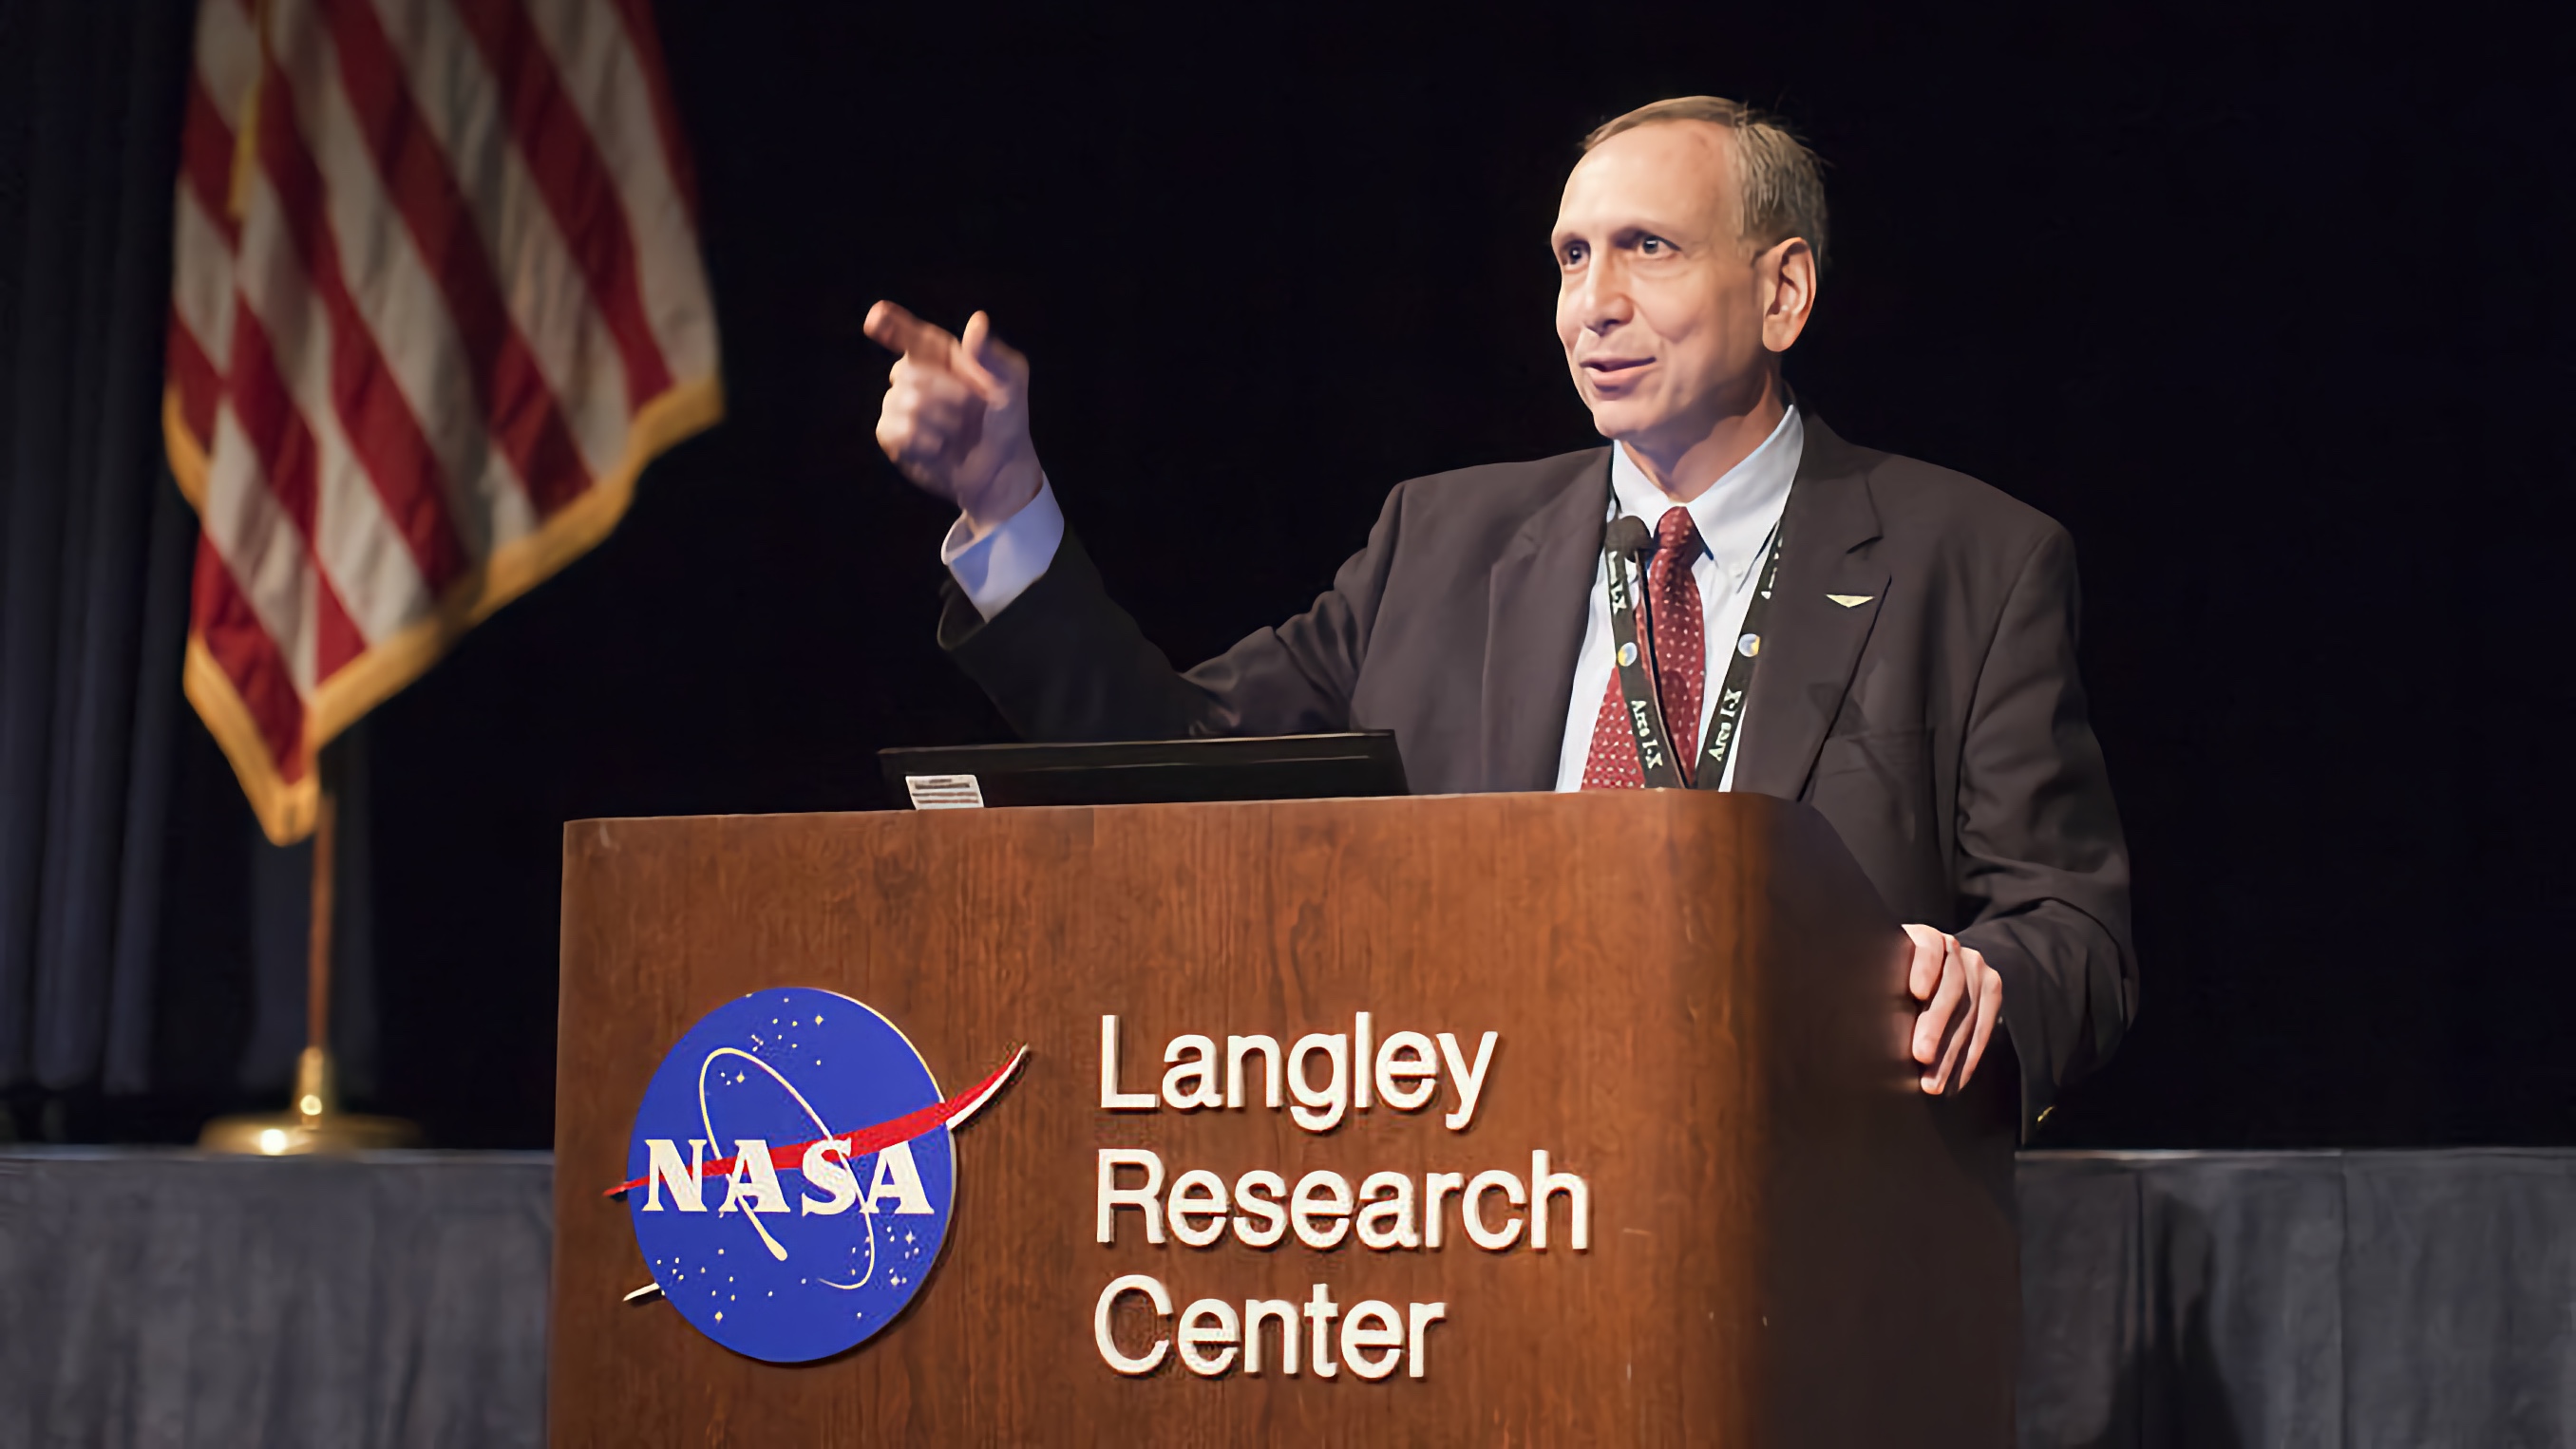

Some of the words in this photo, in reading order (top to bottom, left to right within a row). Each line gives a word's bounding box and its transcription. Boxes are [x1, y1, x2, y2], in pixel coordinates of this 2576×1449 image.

[1100, 1011, 1498, 1132] Langley
[641, 1137, 935, 1217] NASA
[1096, 1148, 1589, 1251] Research
[1094, 1274, 1447, 1379] Center
